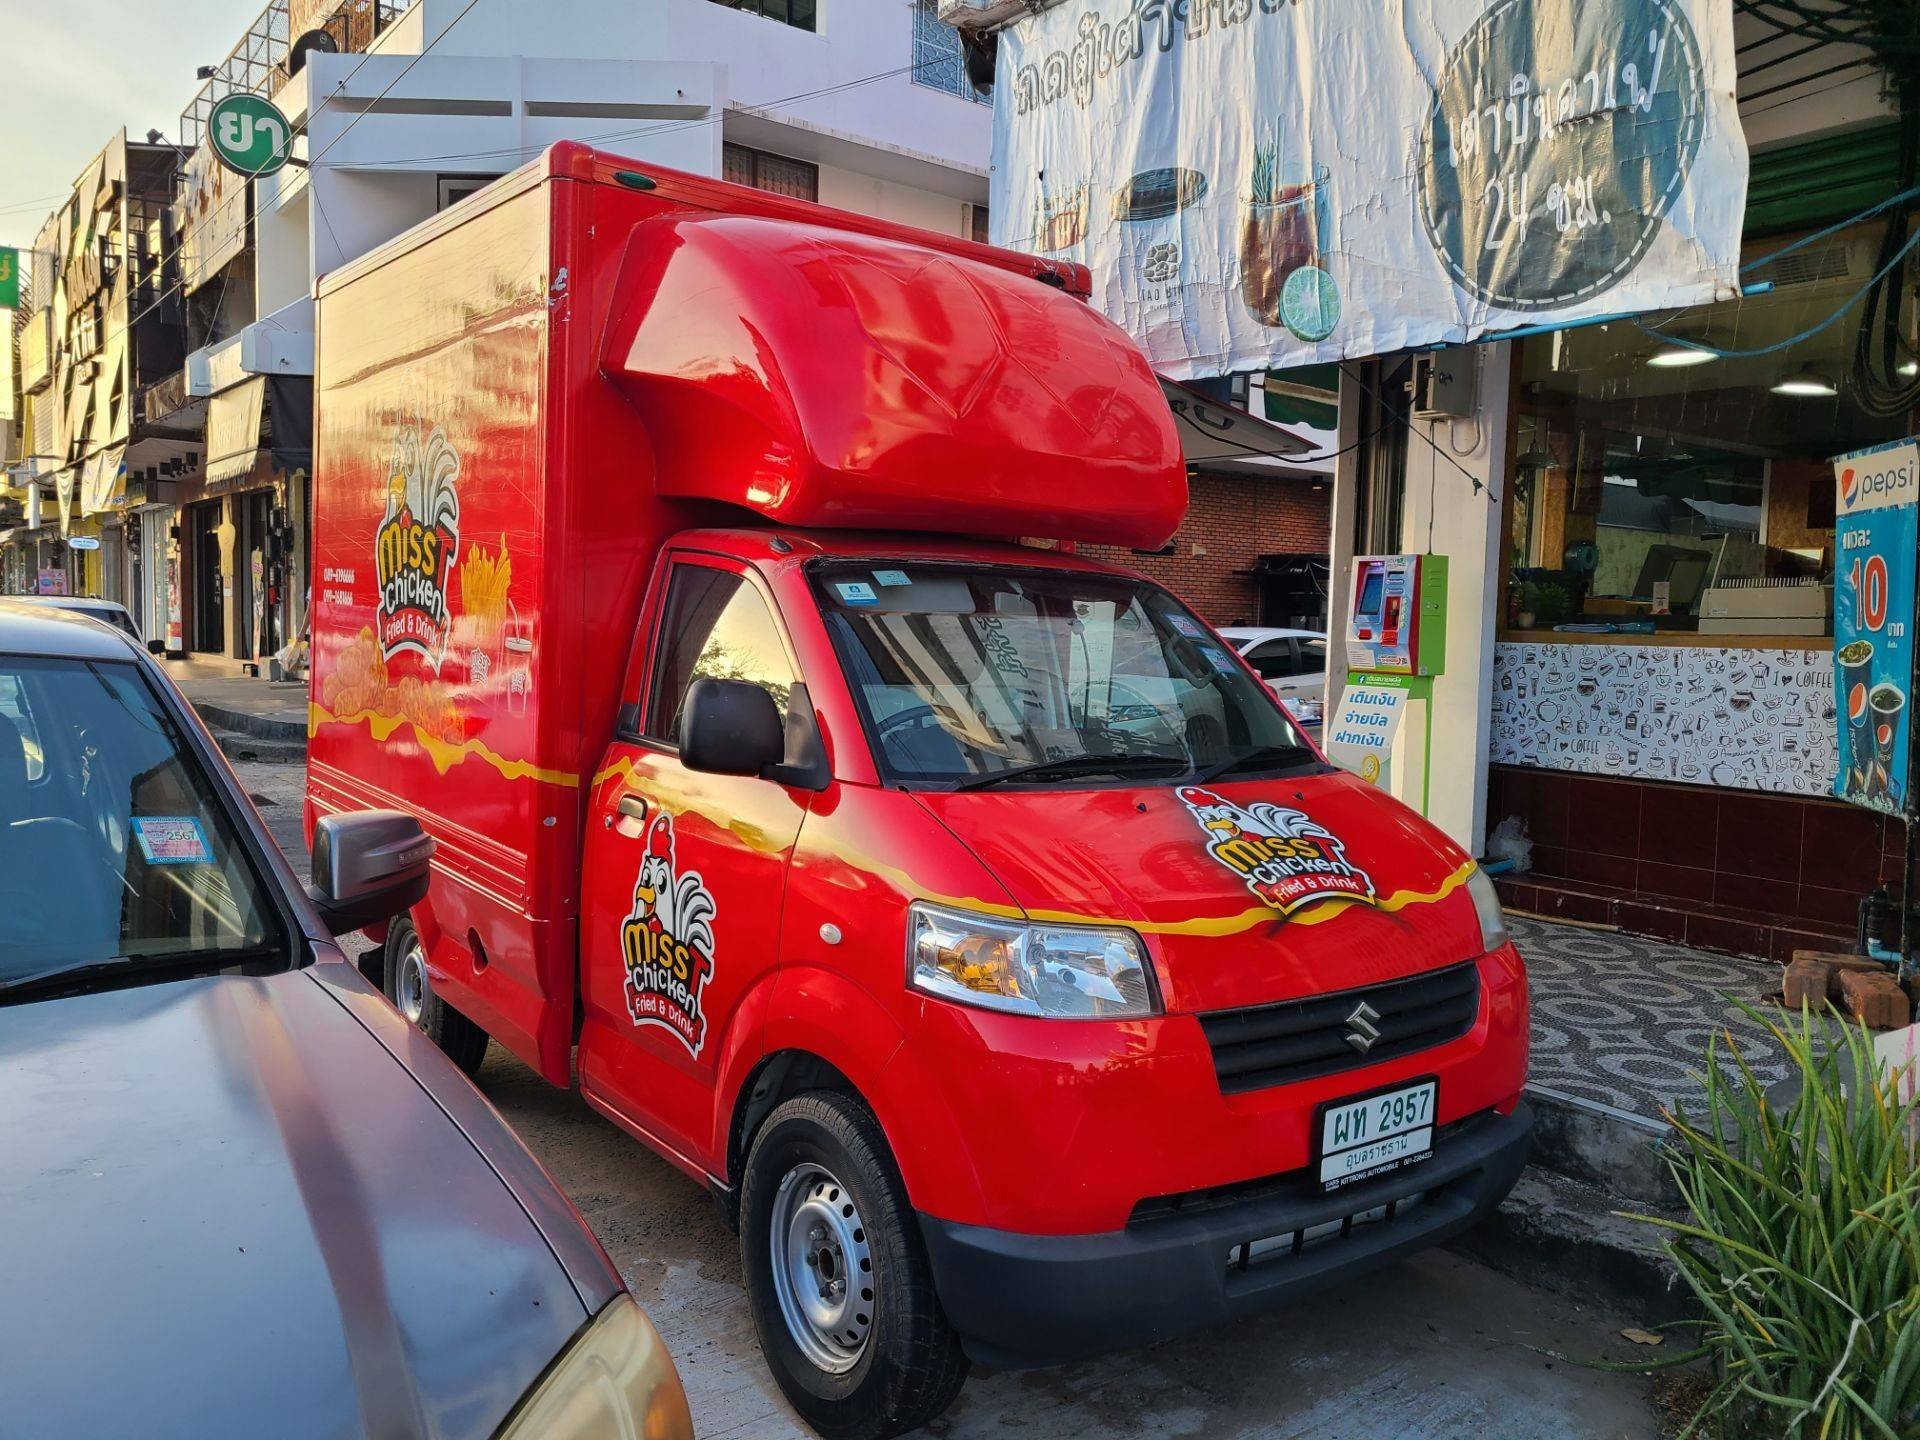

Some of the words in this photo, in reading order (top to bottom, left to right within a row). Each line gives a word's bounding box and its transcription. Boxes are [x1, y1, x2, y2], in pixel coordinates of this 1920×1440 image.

[218, 111, 285, 158] ยา
[1484, 171, 1529, 250] 24
[1861, 460, 1914, 502] pepsi
[1850, 554, 1888, 632] 10
[1349, 691, 1397, 706] เติมเงิน
[1796, 671, 1833, 689] COFFEE
[1345, 710, 1388, 727] จ่ายบิล
[1335, 731, 1385, 747] ฝากเงิน
[1570, 739, 1600, 755] COFFEE
[1274, 879, 1306, 903] Fried
[1320, 875, 1360, 891] Drink
[636, 994, 657, 1014] Fried
[669, 1007, 694, 1038] Drink
[1334, 1106, 1367, 1145] ผท
[1379, 1089, 1431, 1133] 2957
[1346, 1133, 1408, 1171] อุบลราชธานี
